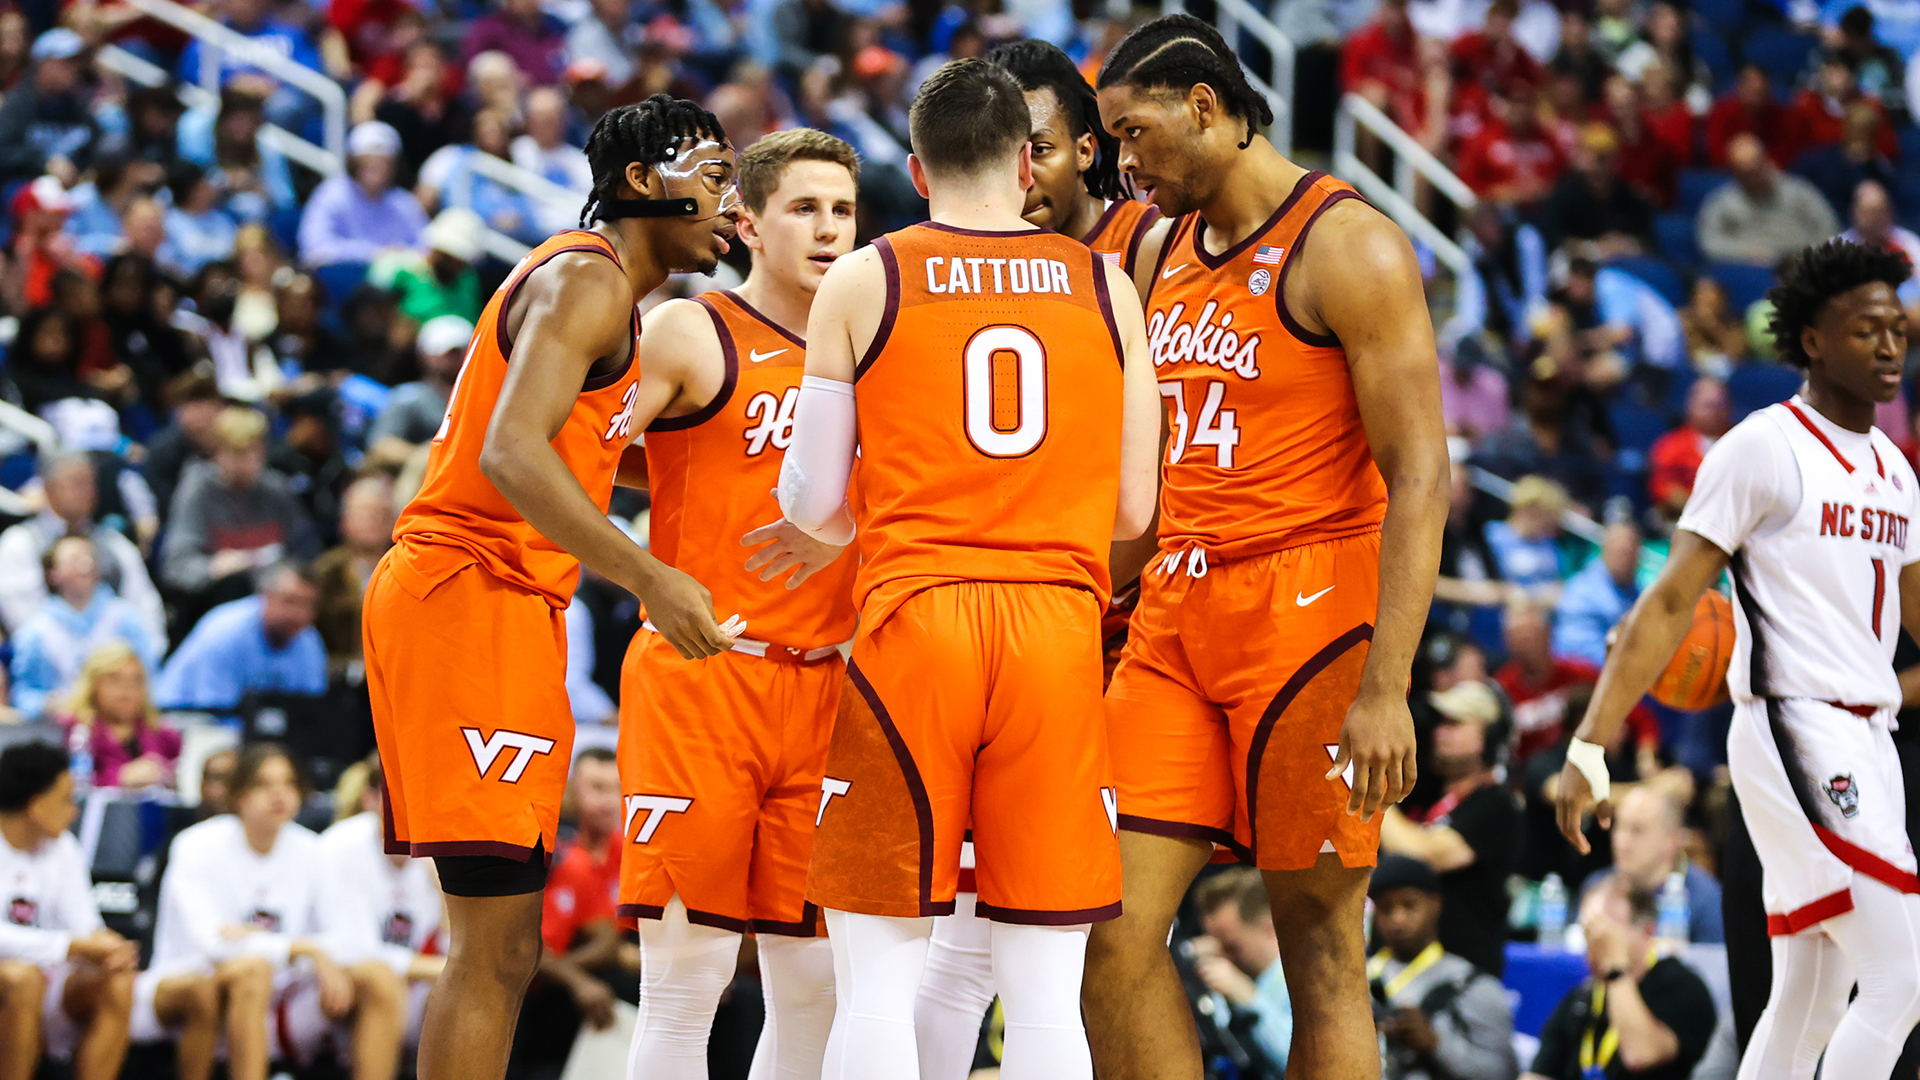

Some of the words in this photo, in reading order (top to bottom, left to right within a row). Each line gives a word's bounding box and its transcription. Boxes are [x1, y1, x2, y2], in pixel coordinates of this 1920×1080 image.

[925, 256, 1073, 295] CATTOOR
[1149, 299, 1261, 380] Hokies
[962, 323, 1048, 459] 0
[1158, 379, 1241, 468] 34
[1820, 502, 1855, 538] NC
[1861, 507, 1909, 551] STAT
[1870, 557, 1886, 643] 1
[459, 726, 557, 784] VT
